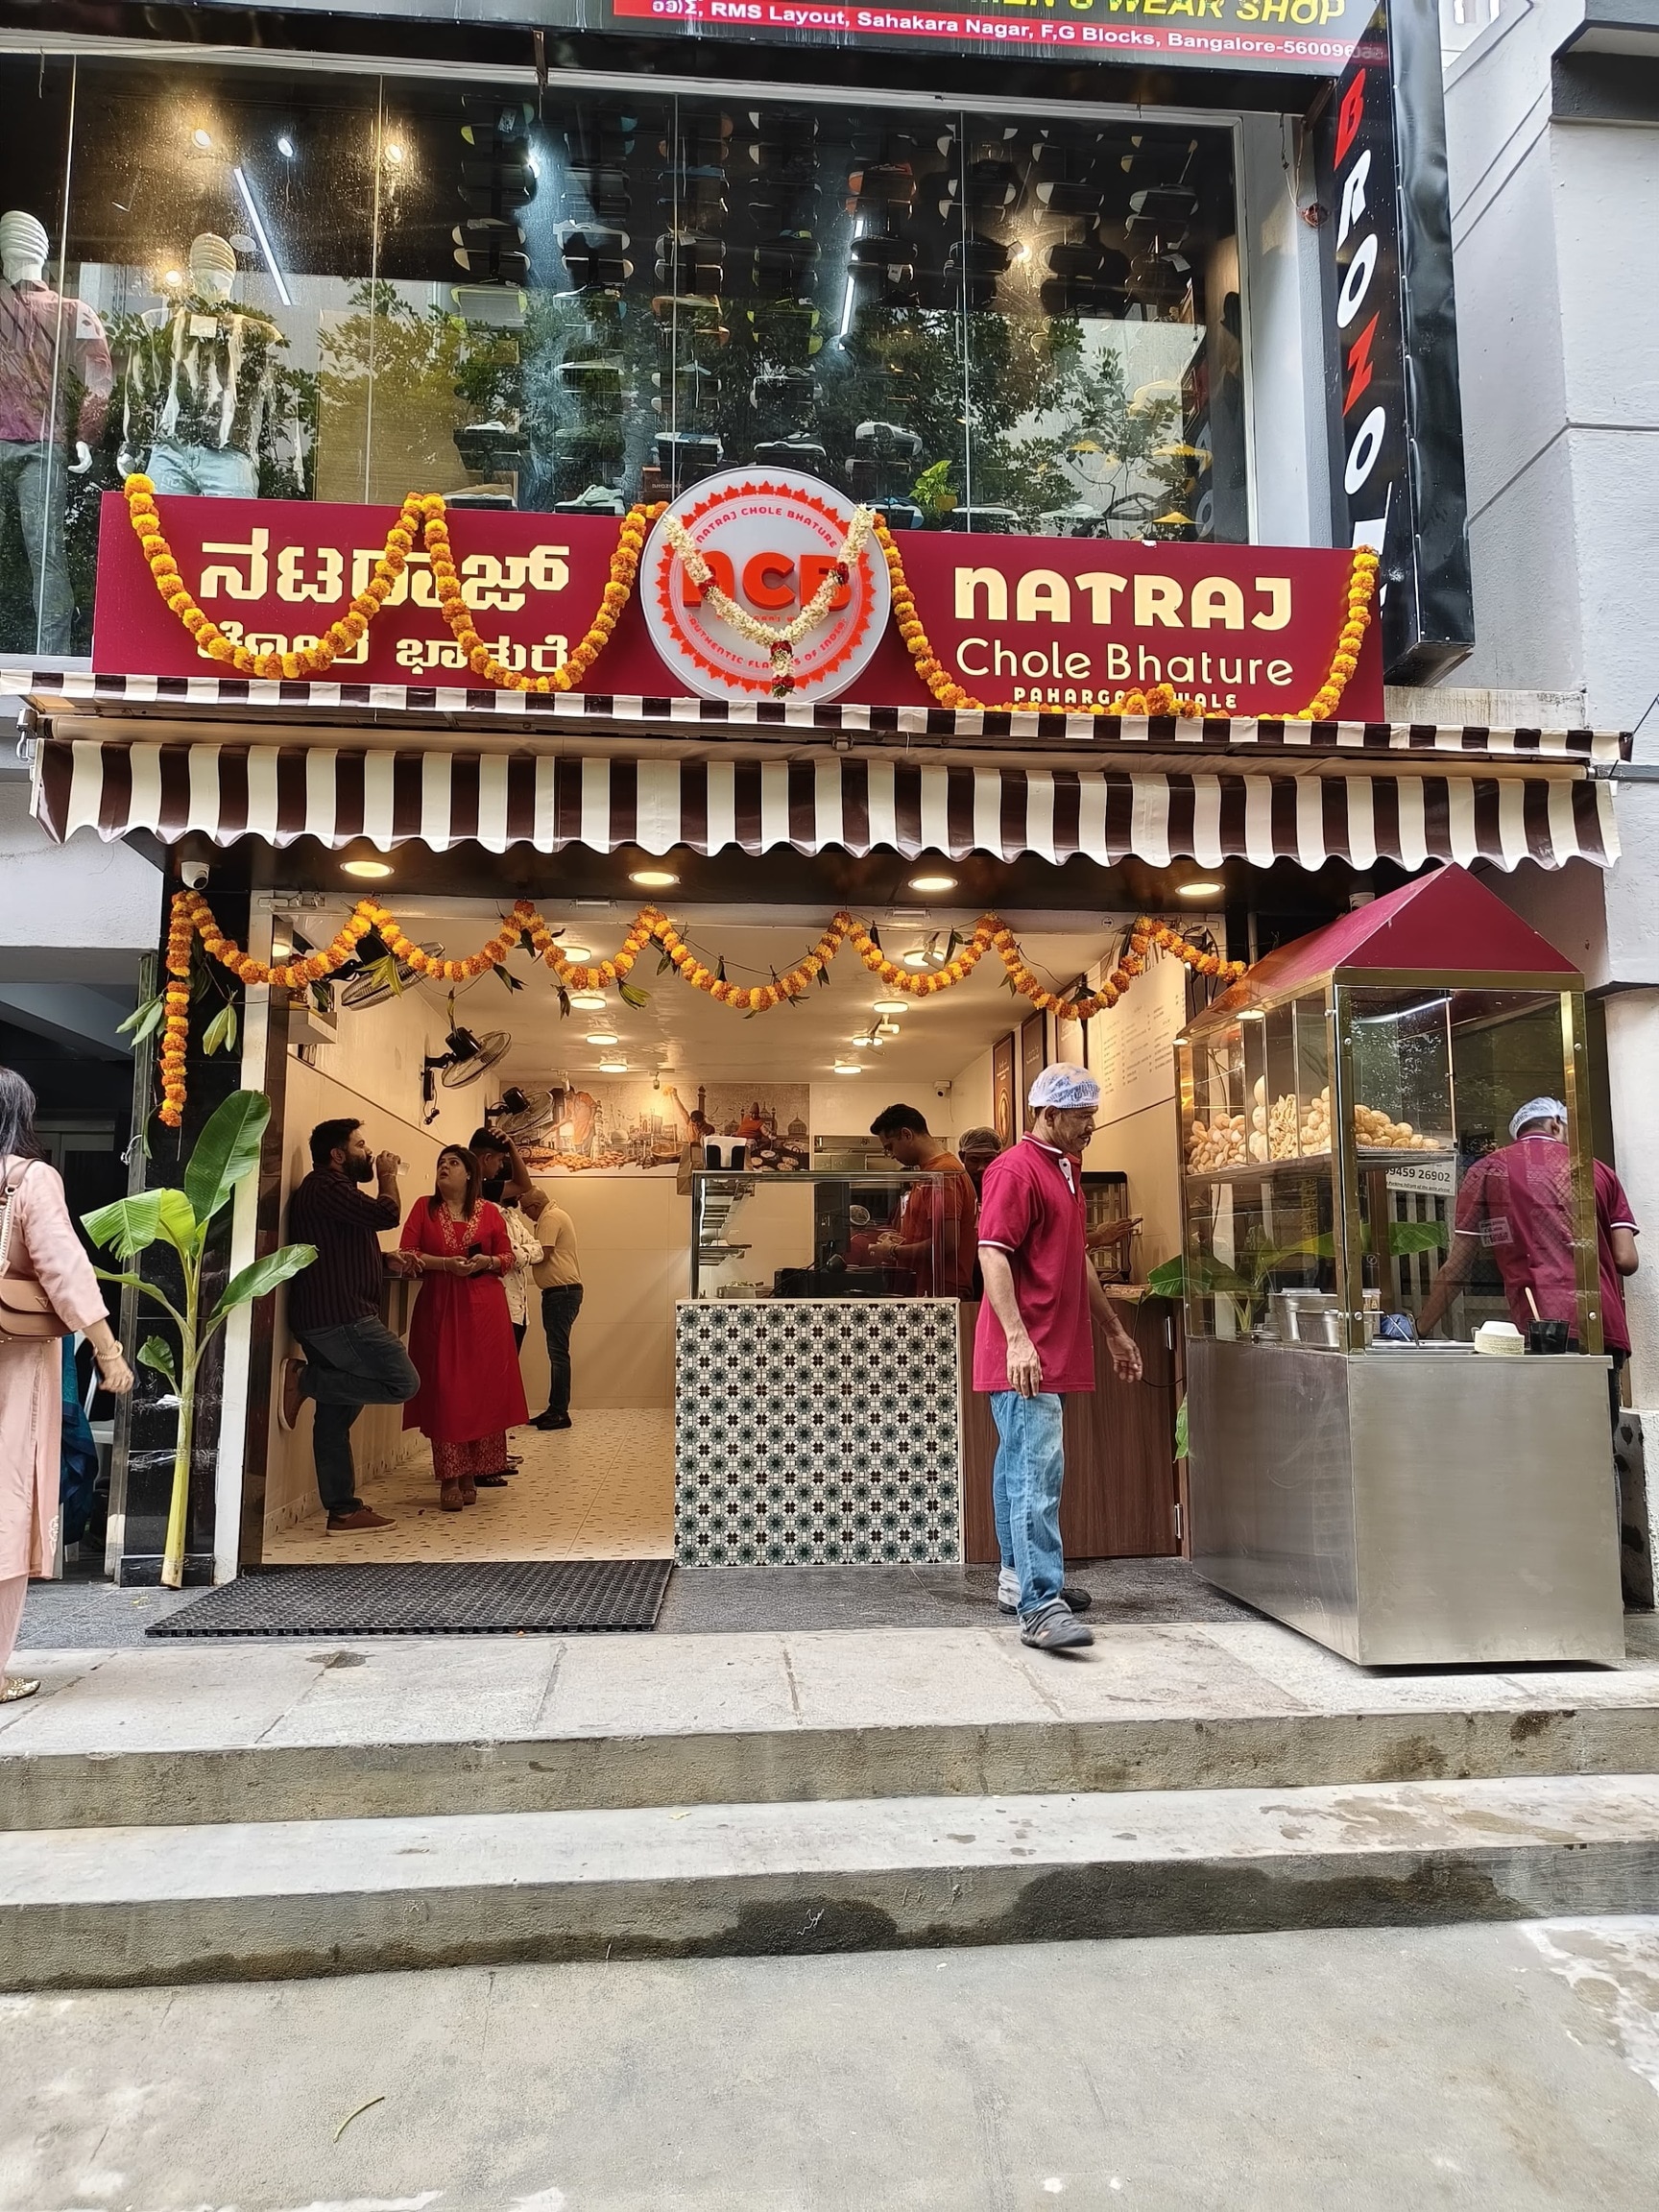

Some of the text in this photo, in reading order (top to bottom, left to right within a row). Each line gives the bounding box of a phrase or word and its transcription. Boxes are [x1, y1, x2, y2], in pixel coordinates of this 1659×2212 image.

[711, 5, 762, 18] RMS
[769, 6, 850, 28] Layout,
[857, 12, 958, 32] Sahakara
[966, 19, 1033, 38] Nagar,
[1041, 24, 1075, 41] F,G
[1082, 28, 1161, 47] Blocks,
[1237, 0, 1345, 25] SHOP
[695, 506, 837, 548] NATRAJ CHOLE BHATURE
[683, 550, 853, 613] NCB
[954, 567, 1291, 631] NATRAJ
[688, 617, 743, 663] AUTHENTIC
[748, 658, 801, 669] FLAS
[805, 652, 817, 661] OF
[955, 637, 1294, 686] Chole Bhature
[1014, 686, 1125, 705] PAHARGA
[1418, 1169, 1451, 1182] 26902
